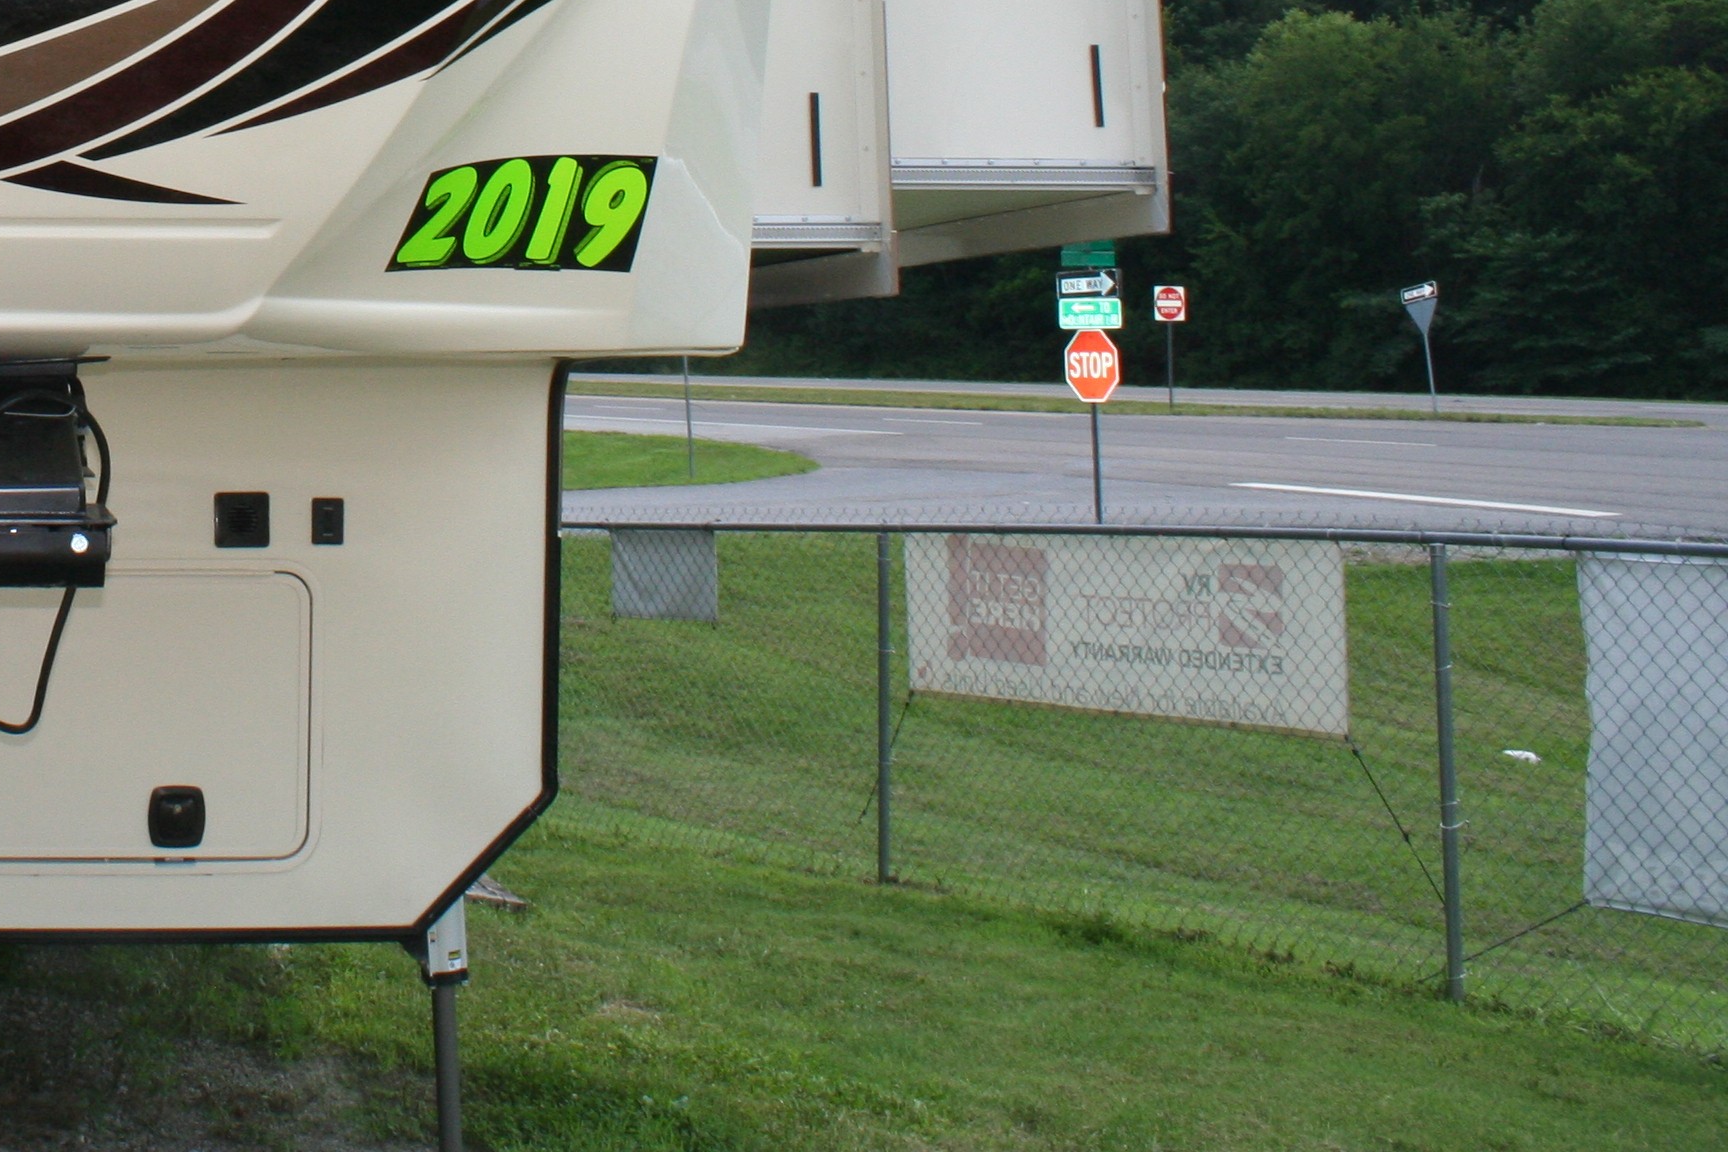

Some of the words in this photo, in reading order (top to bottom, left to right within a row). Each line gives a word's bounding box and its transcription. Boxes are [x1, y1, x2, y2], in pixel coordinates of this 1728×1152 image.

[395, 156, 648, 268] 2019
[1063, 280, 1081, 292] ONE
[1085, 278, 1104, 290] WAY
[1069, 351, 1113, 379] STOP
